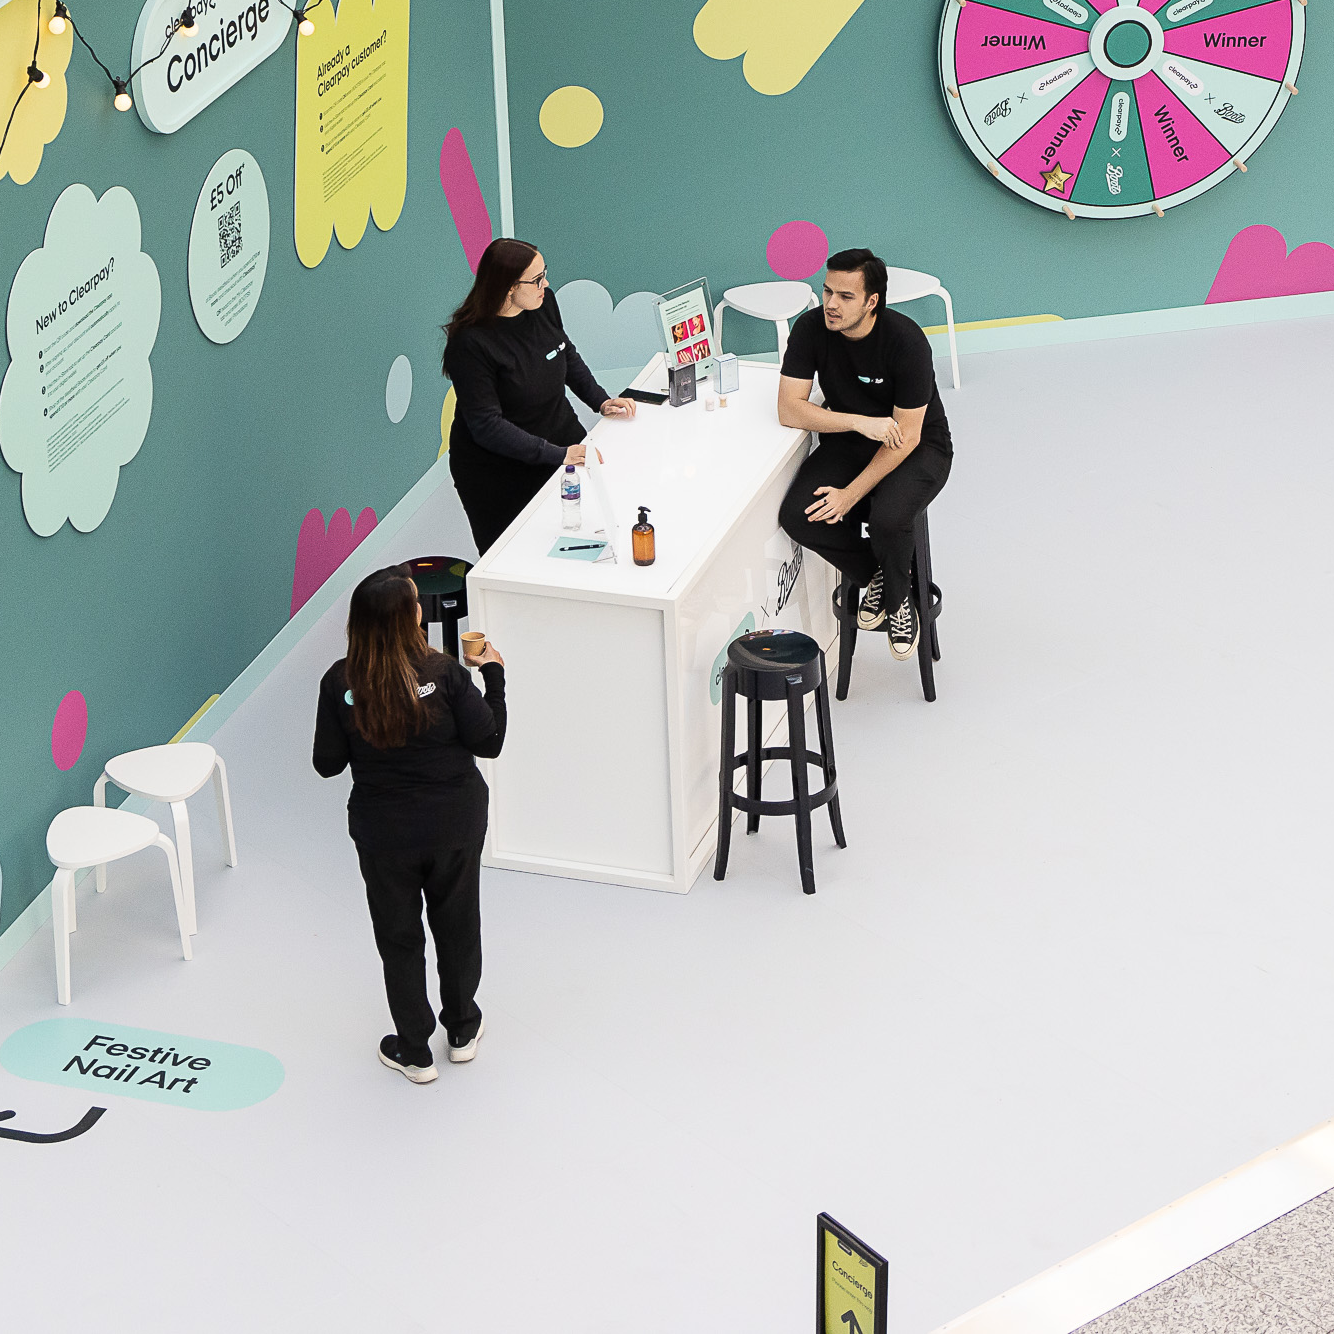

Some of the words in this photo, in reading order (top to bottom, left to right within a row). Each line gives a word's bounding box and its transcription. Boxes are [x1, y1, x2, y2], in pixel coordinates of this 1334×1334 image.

[981, 35, 1047, 50] Winner
[1203, 33, 1267, 48] Winner
[317, 50, 344, 80] Already
[345, 45, 350, 56] a
[318, 63, 350, 97] Clearpay
[351, 30, 387, 69] customer?
[984, 97, 1012, 126] Boots
[1168, 65, 1191, 87] clearpay
[1214, 103, 1245, 124] Boots
[1117, 98, 1125, 129] clearpay
[1041, 108, 1087, 164] Winner
[1154, 105, 1189, 164] Winner
[210, 182, 223, 211] £5
[1106, 163, 1123, 195] Boots
[36, 308, 56, 334] New
[58, 301, 67, 315] to
[68, 257, 115, 307] Clearpay?
[83, 1035, 211, 1070] Festive
[62, 1055, 140, 1082] Nail
[137, 1070, 198, 1093] Art
[832, 1261, 873, 1299] Concierge
